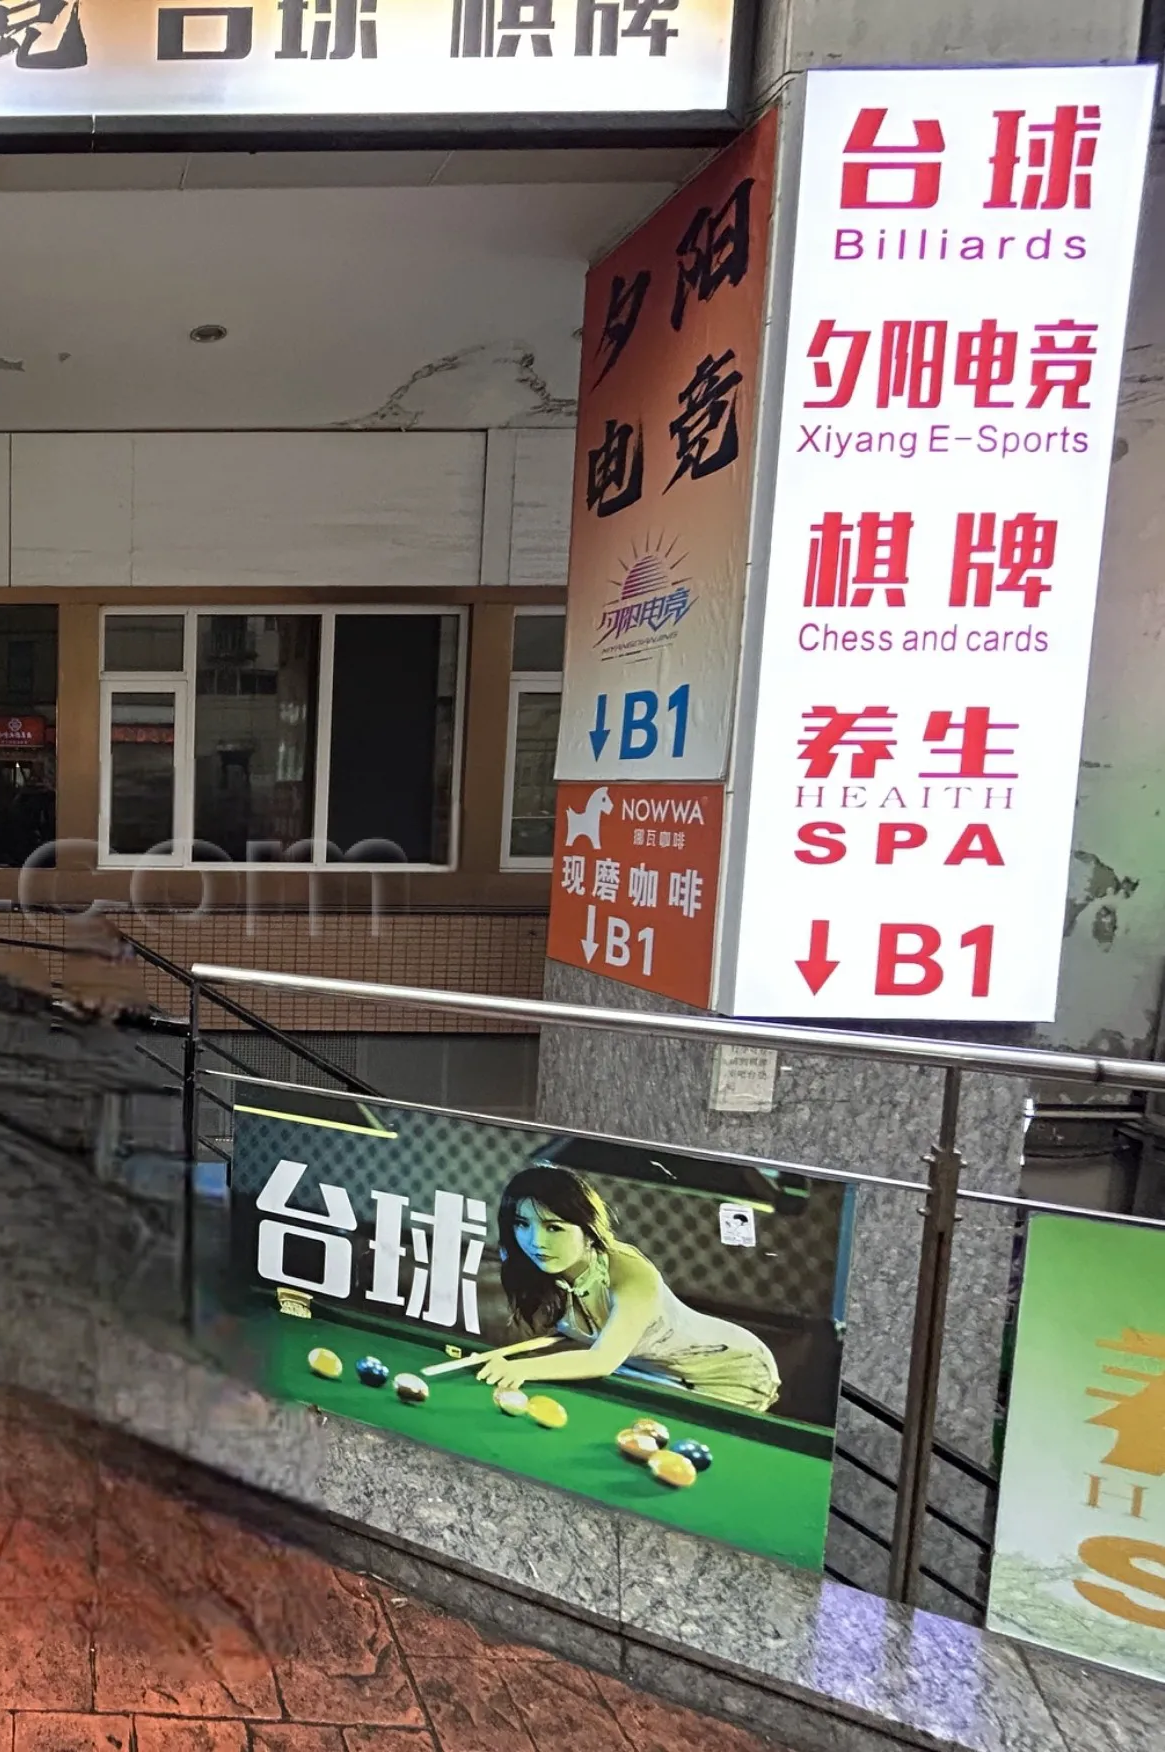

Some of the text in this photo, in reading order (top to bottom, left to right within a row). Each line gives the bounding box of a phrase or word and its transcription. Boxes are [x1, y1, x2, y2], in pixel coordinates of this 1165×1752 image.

[840, 104, 1102, 210] 台球
[834, 228, 1087, 260] Billiards
[591, 178, 755, 393] 夕阳
[803, 319, 1099, 409] 夕阳电竞
[586, 349, 744, 518] 电竞
[796, 425, 1089, 459] Xiyang E-Sports
[802, 512, 1059, 608] 棋牌
[798, 623, 1050, 652] Chess and cards
[619, 684, 690, 760] B1
[797, 706, 1020, 779] 养生
[621, 798, 704, 825] NOWWA
[794, 785, 1014, 809] HEAITH
[794, 821, 1005, 866] SPA
[561, 855, 704, 918] 现磨咖啡
[605, 916, 654, 976] B1
[874, 923, 995, 998] B1
[256, 1159, 488, 1335] 台球
